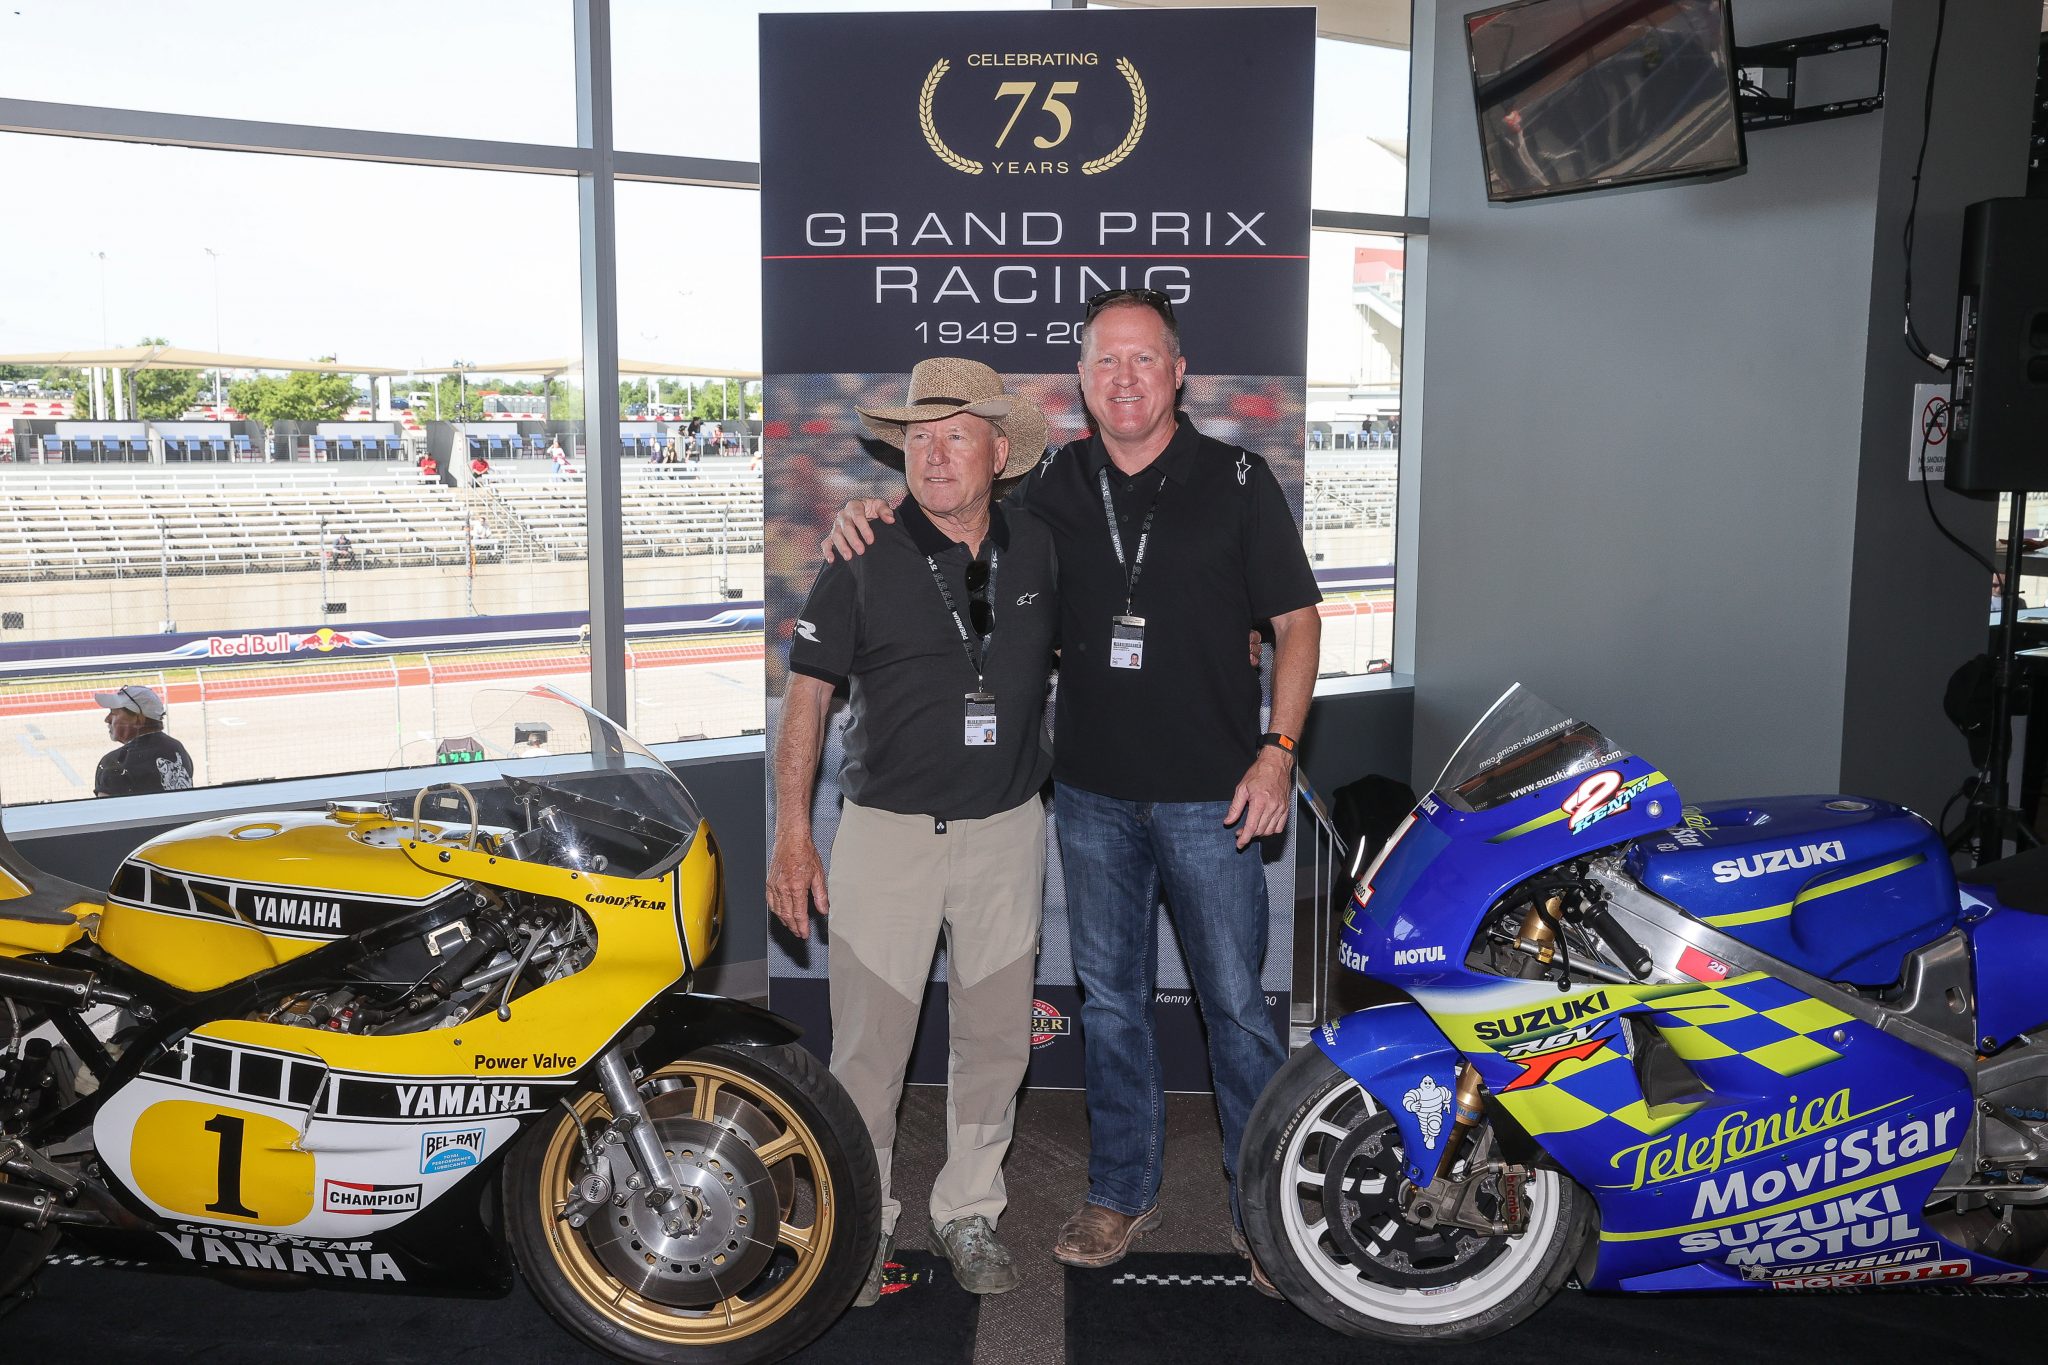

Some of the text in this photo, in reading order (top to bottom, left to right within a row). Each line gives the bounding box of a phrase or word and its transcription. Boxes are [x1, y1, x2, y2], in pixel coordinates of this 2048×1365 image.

[967, 53, 1098, 67] CELEBRATING
[995, 81, 1079, 149] 75
[992, 161, 1070, 174] YEARS
[805, 211, 1268, 247] GRAND PRIX
[875, 265, 1191, 305] RACING
[1111, 533, 1125, 564] PREMIUM
[1135, 533, 1148, 564] PREMIUM
[951, 610, 969, 641] PREMIUM
[1561, 769, 1631, 831] 2
[1571, 776, 1650, 836] KENNY
[1712, 840, 1846, 883] SUZUKI
[253, 895, 342, 928] YAMAHA
[1394, 946, 1447, 966] MOTUL
[1707, 961, 1728, 976] 2D
[1155, 992, 1191, 1006] Kenny
[1473, 990, 1610, 1041] SUZUKI
[1505, 1020, 1609, 1058] RGV
[474, 1053, 577, 1069] Power Valve
[395, 1085, 531, 1117] YAMAHA
[425, 1131, 483, 1160] BEL-RAY
[1274, 1103, 1307, 1161] MICHELIN
[1610, 1087, 1853, 1191] Telefonica
[204, 1113, 259, 1219] 1
[1691, 1106, 1956, 1220] MoviStar
[329, 1191, 415, 1206] CHAMPION
[1506, 1174, 1518, 1222] brembo
[1680, 1184, 1902, 1253] SUZUKI
[155, 1231, 407, 1282] YAMAHA
[1725, 1213, 1920, 1266] MOTUL
[1773, 1247, 1930, 1277] MICHELIN
[1775, 1275, 1856, 1290] NGK
